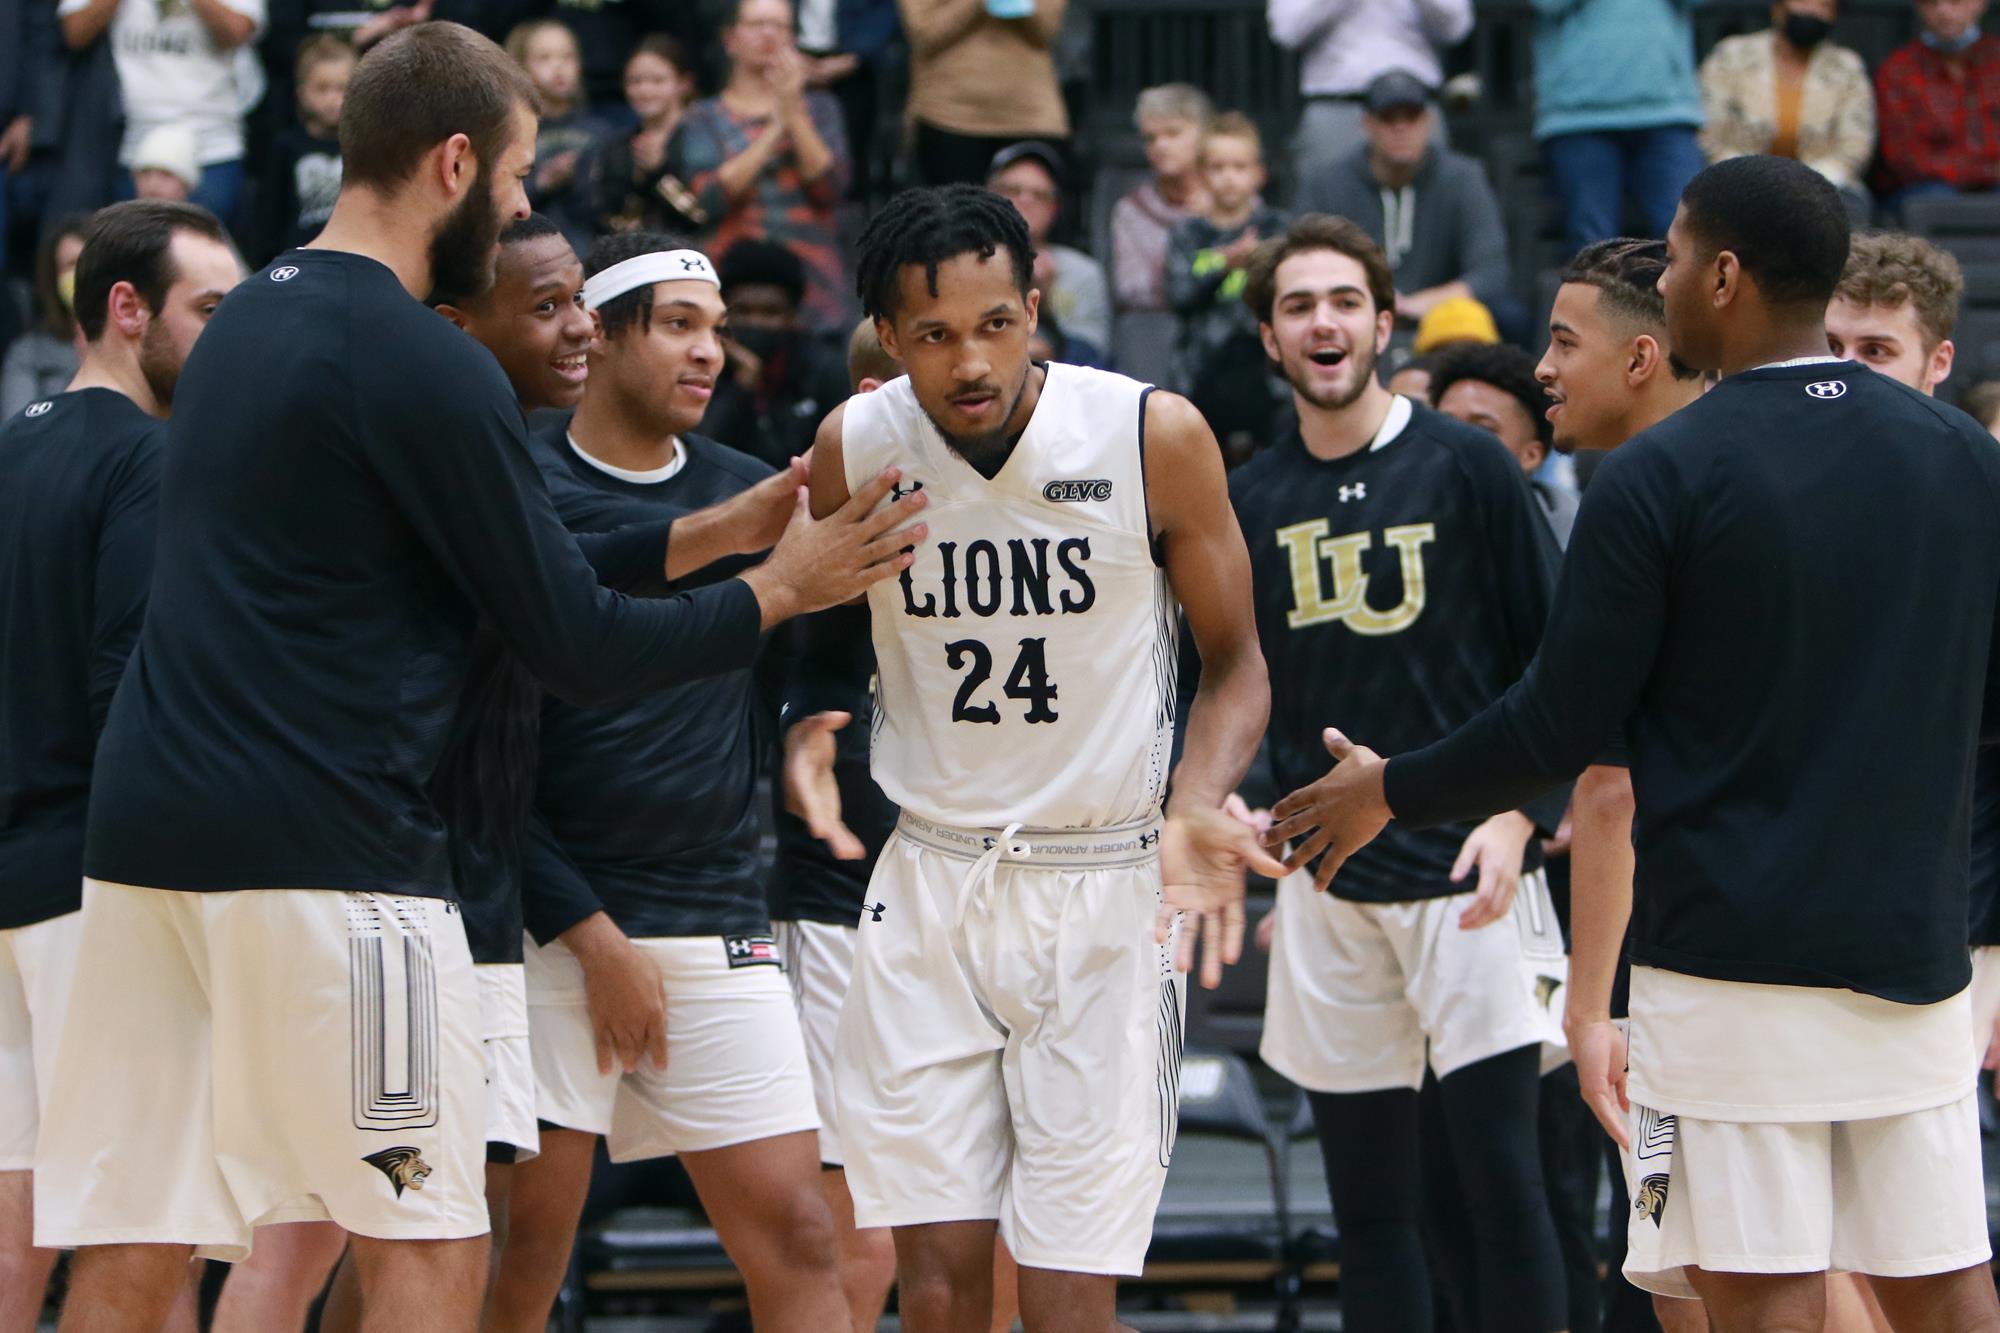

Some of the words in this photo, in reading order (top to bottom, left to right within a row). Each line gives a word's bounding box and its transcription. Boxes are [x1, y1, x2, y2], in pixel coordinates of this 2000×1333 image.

[1043, 479, 1112, 502] GLVC
[899, 537, 1096, 618] LIONS
[1276, 518, 1435, 635] LU
[945, 637, 1058, 724] 24
[936, 827, 977, 846] UNDER
[1093, 840, 1136, 854] UNDER
[1030, 844, 1088, 855] ARMOUR
